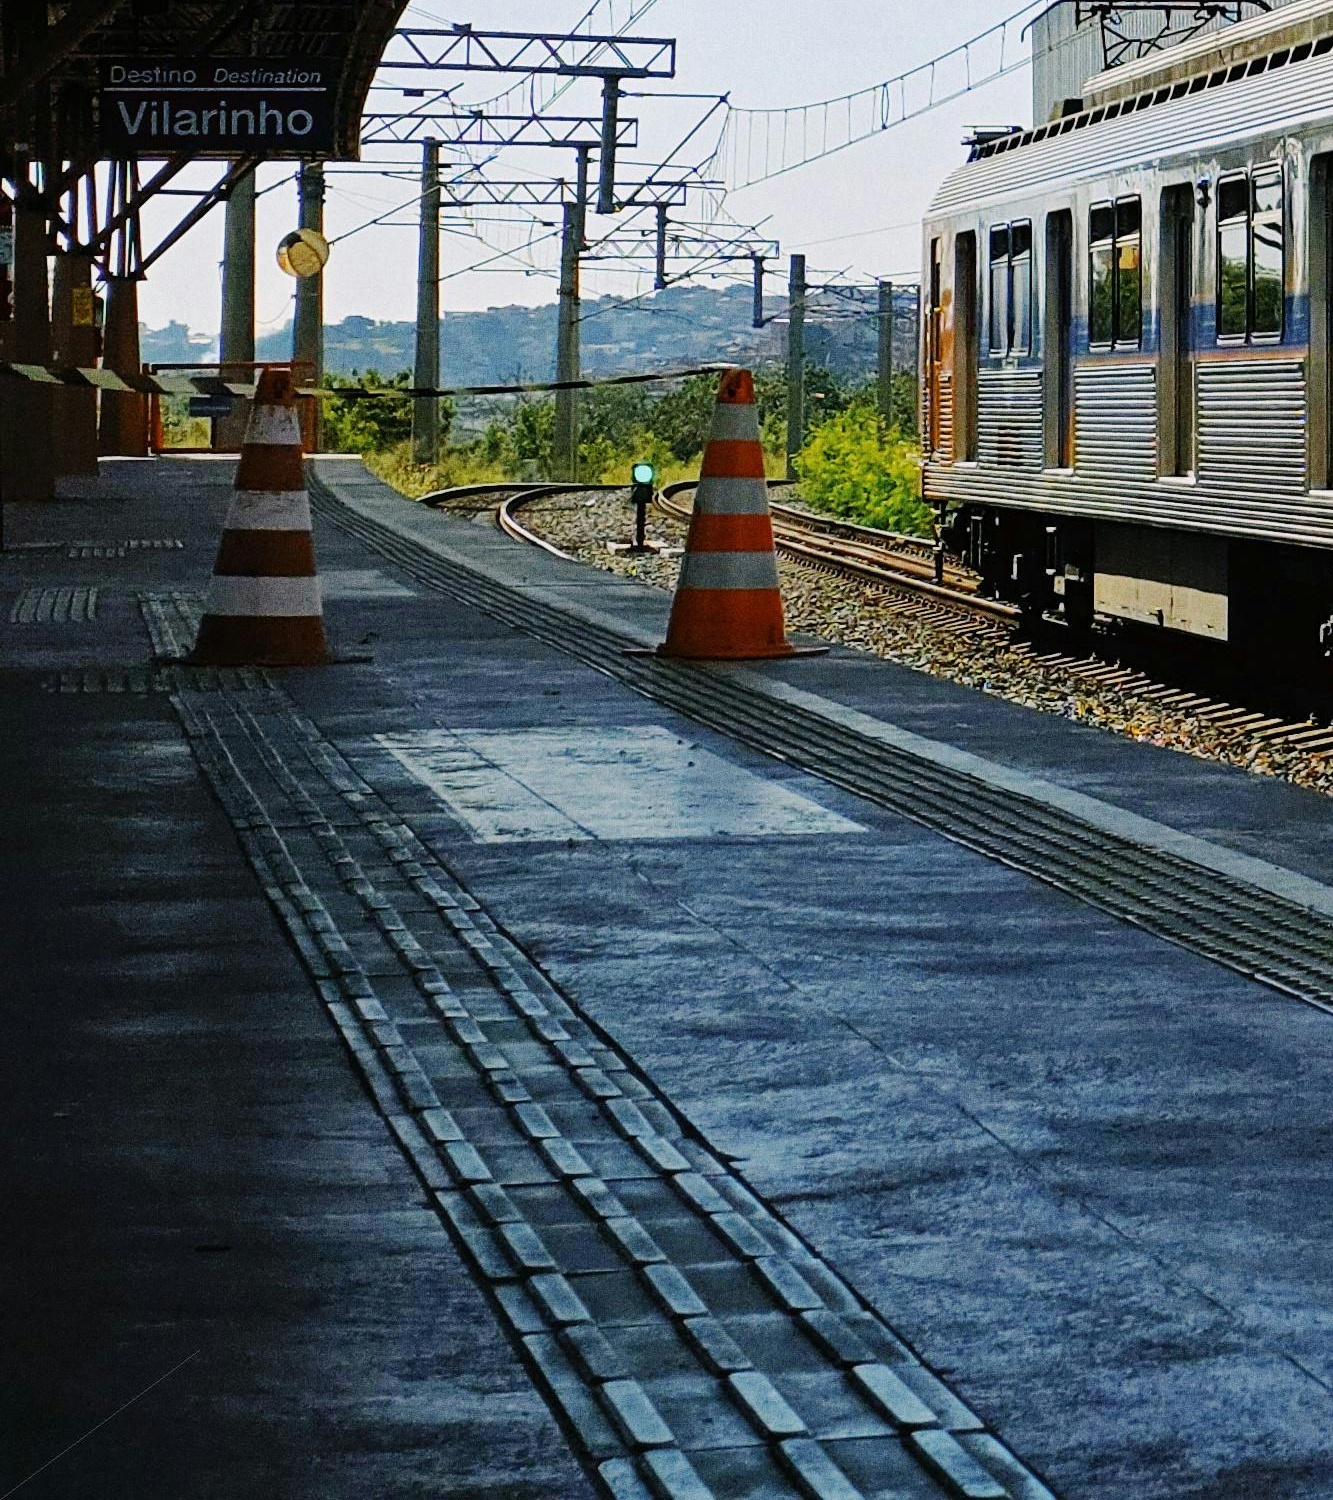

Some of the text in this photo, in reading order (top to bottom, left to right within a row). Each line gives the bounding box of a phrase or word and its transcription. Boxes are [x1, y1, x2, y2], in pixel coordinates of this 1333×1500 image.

[110, 66, 321, 83] Destino Destination
[117, 100, 314, 135] Vilarinho
